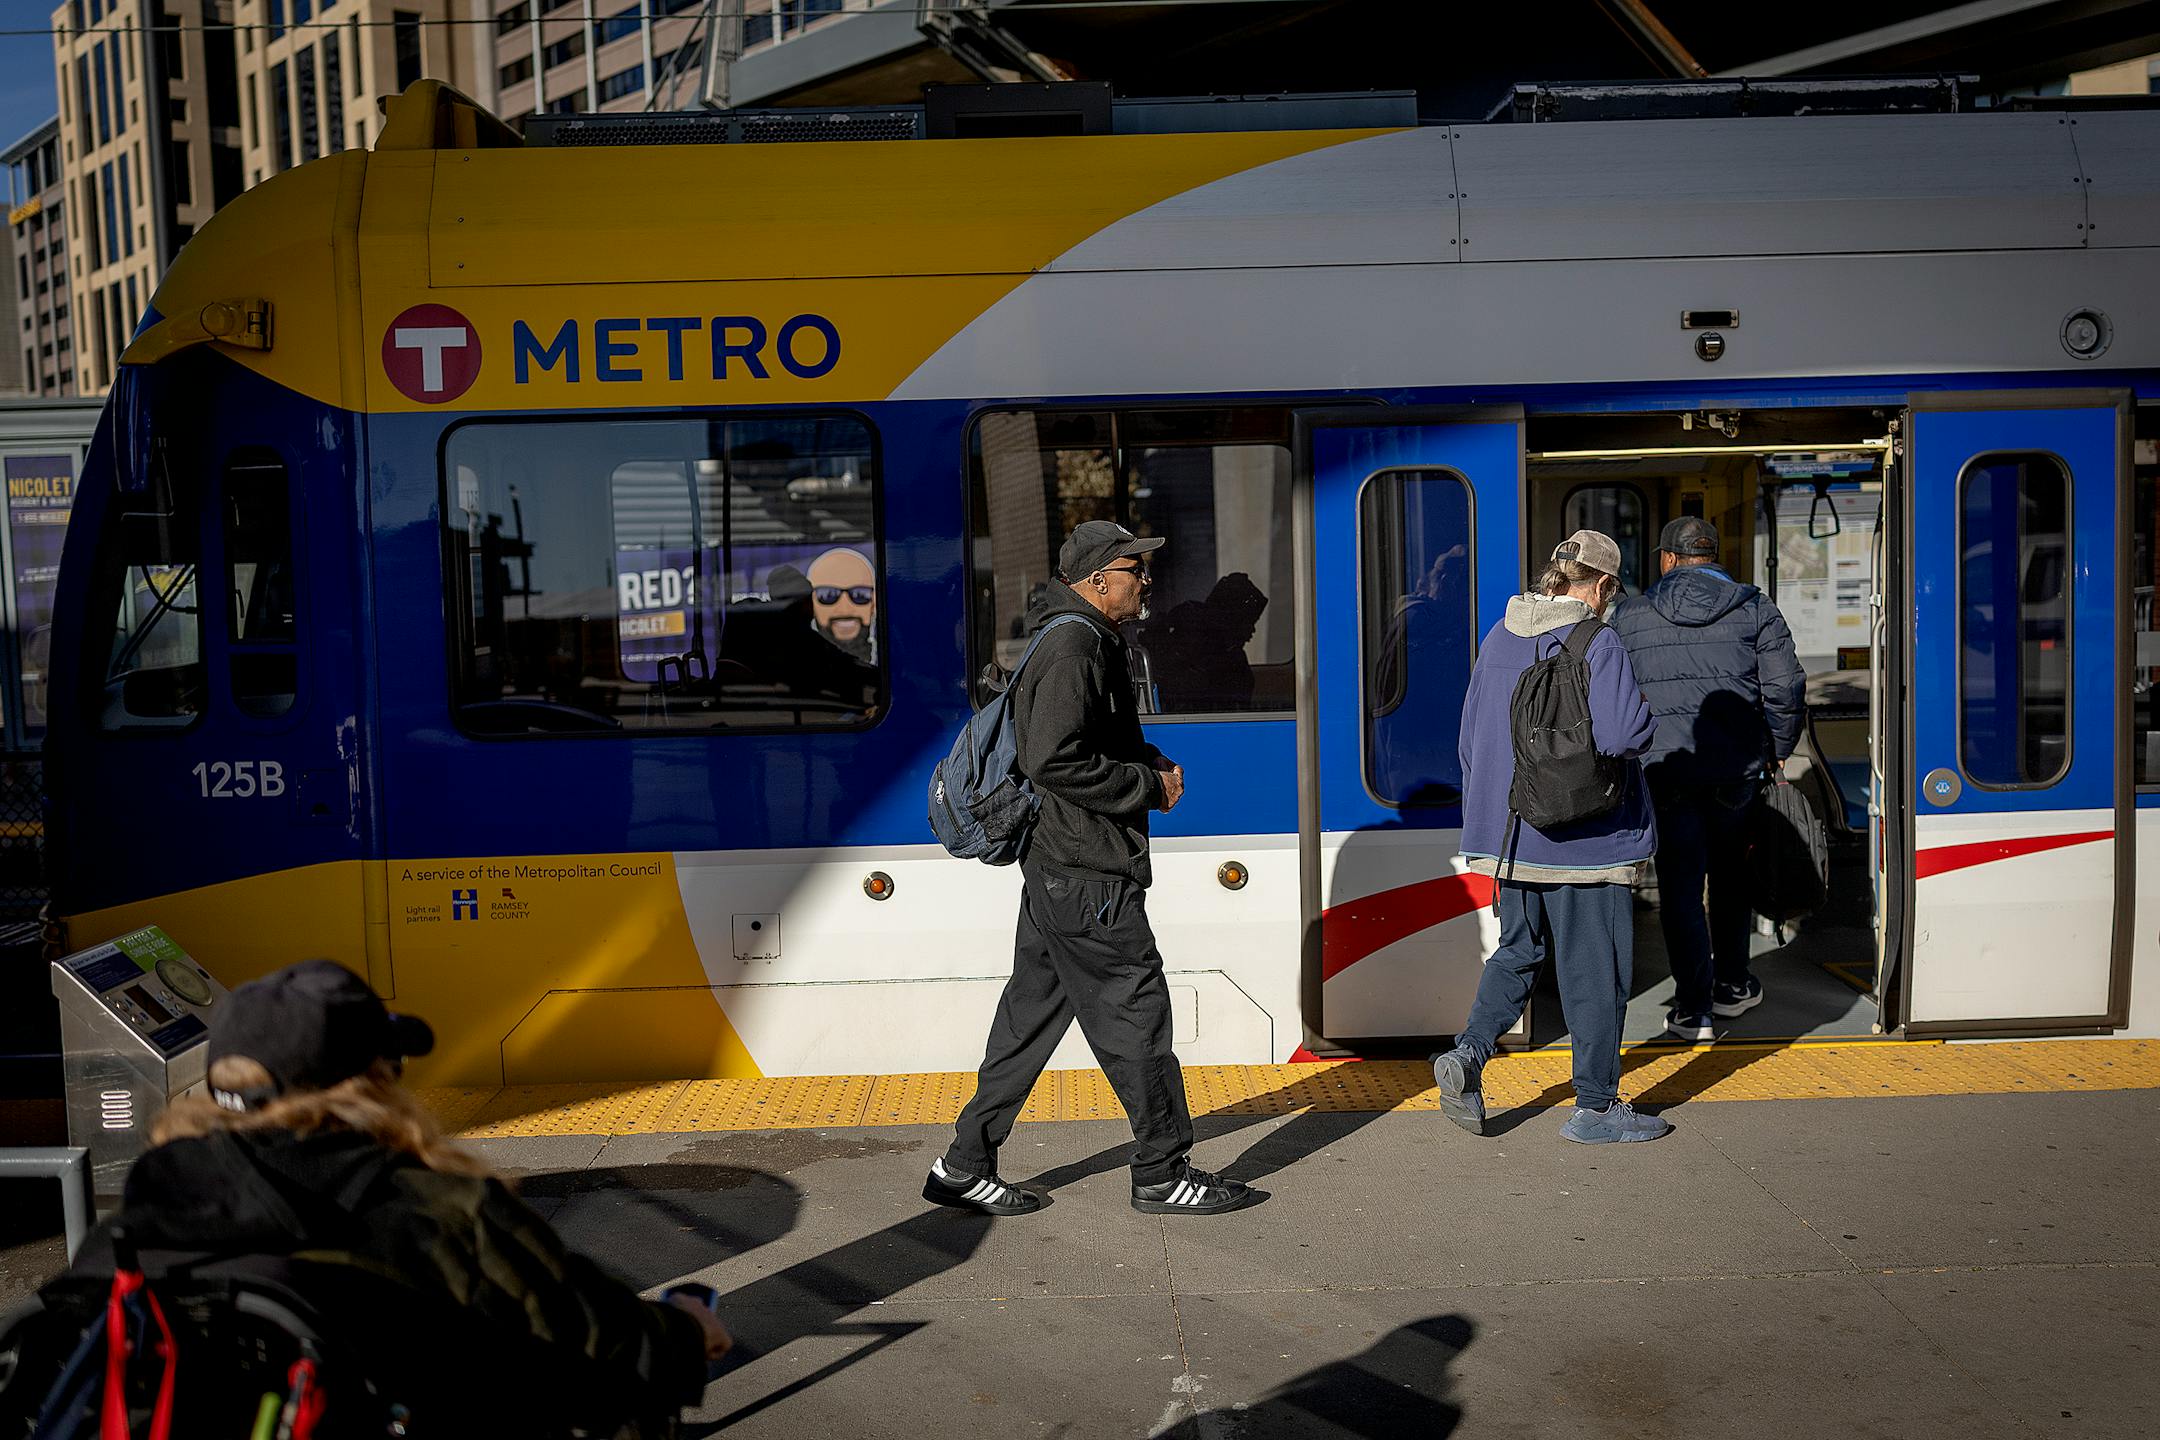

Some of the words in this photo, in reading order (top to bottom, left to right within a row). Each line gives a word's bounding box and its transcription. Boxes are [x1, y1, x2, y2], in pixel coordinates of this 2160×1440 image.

[395, 327, 467, 391] T
[513, 313, 841, 384] METRO
[9, 477, 71, 497] NICOLET
[192, 761, 285, 797] 125B
[401, 869, 413, 881] A
[417, 867, 465, 881] service
[469, 865, 484, 879] of
[488, 865, 510, 879] the
[514, 864, 605, 882] Metropolitan
[609, 861, 661, 878] Council
[406, 905, 426, 915] Light
[427, 904, 441, 913] rail
[491, 901, 529, 911] RAMSEY
[406, 914, 441, 925] partners
[490, 911, 530, 921] COUNTY
